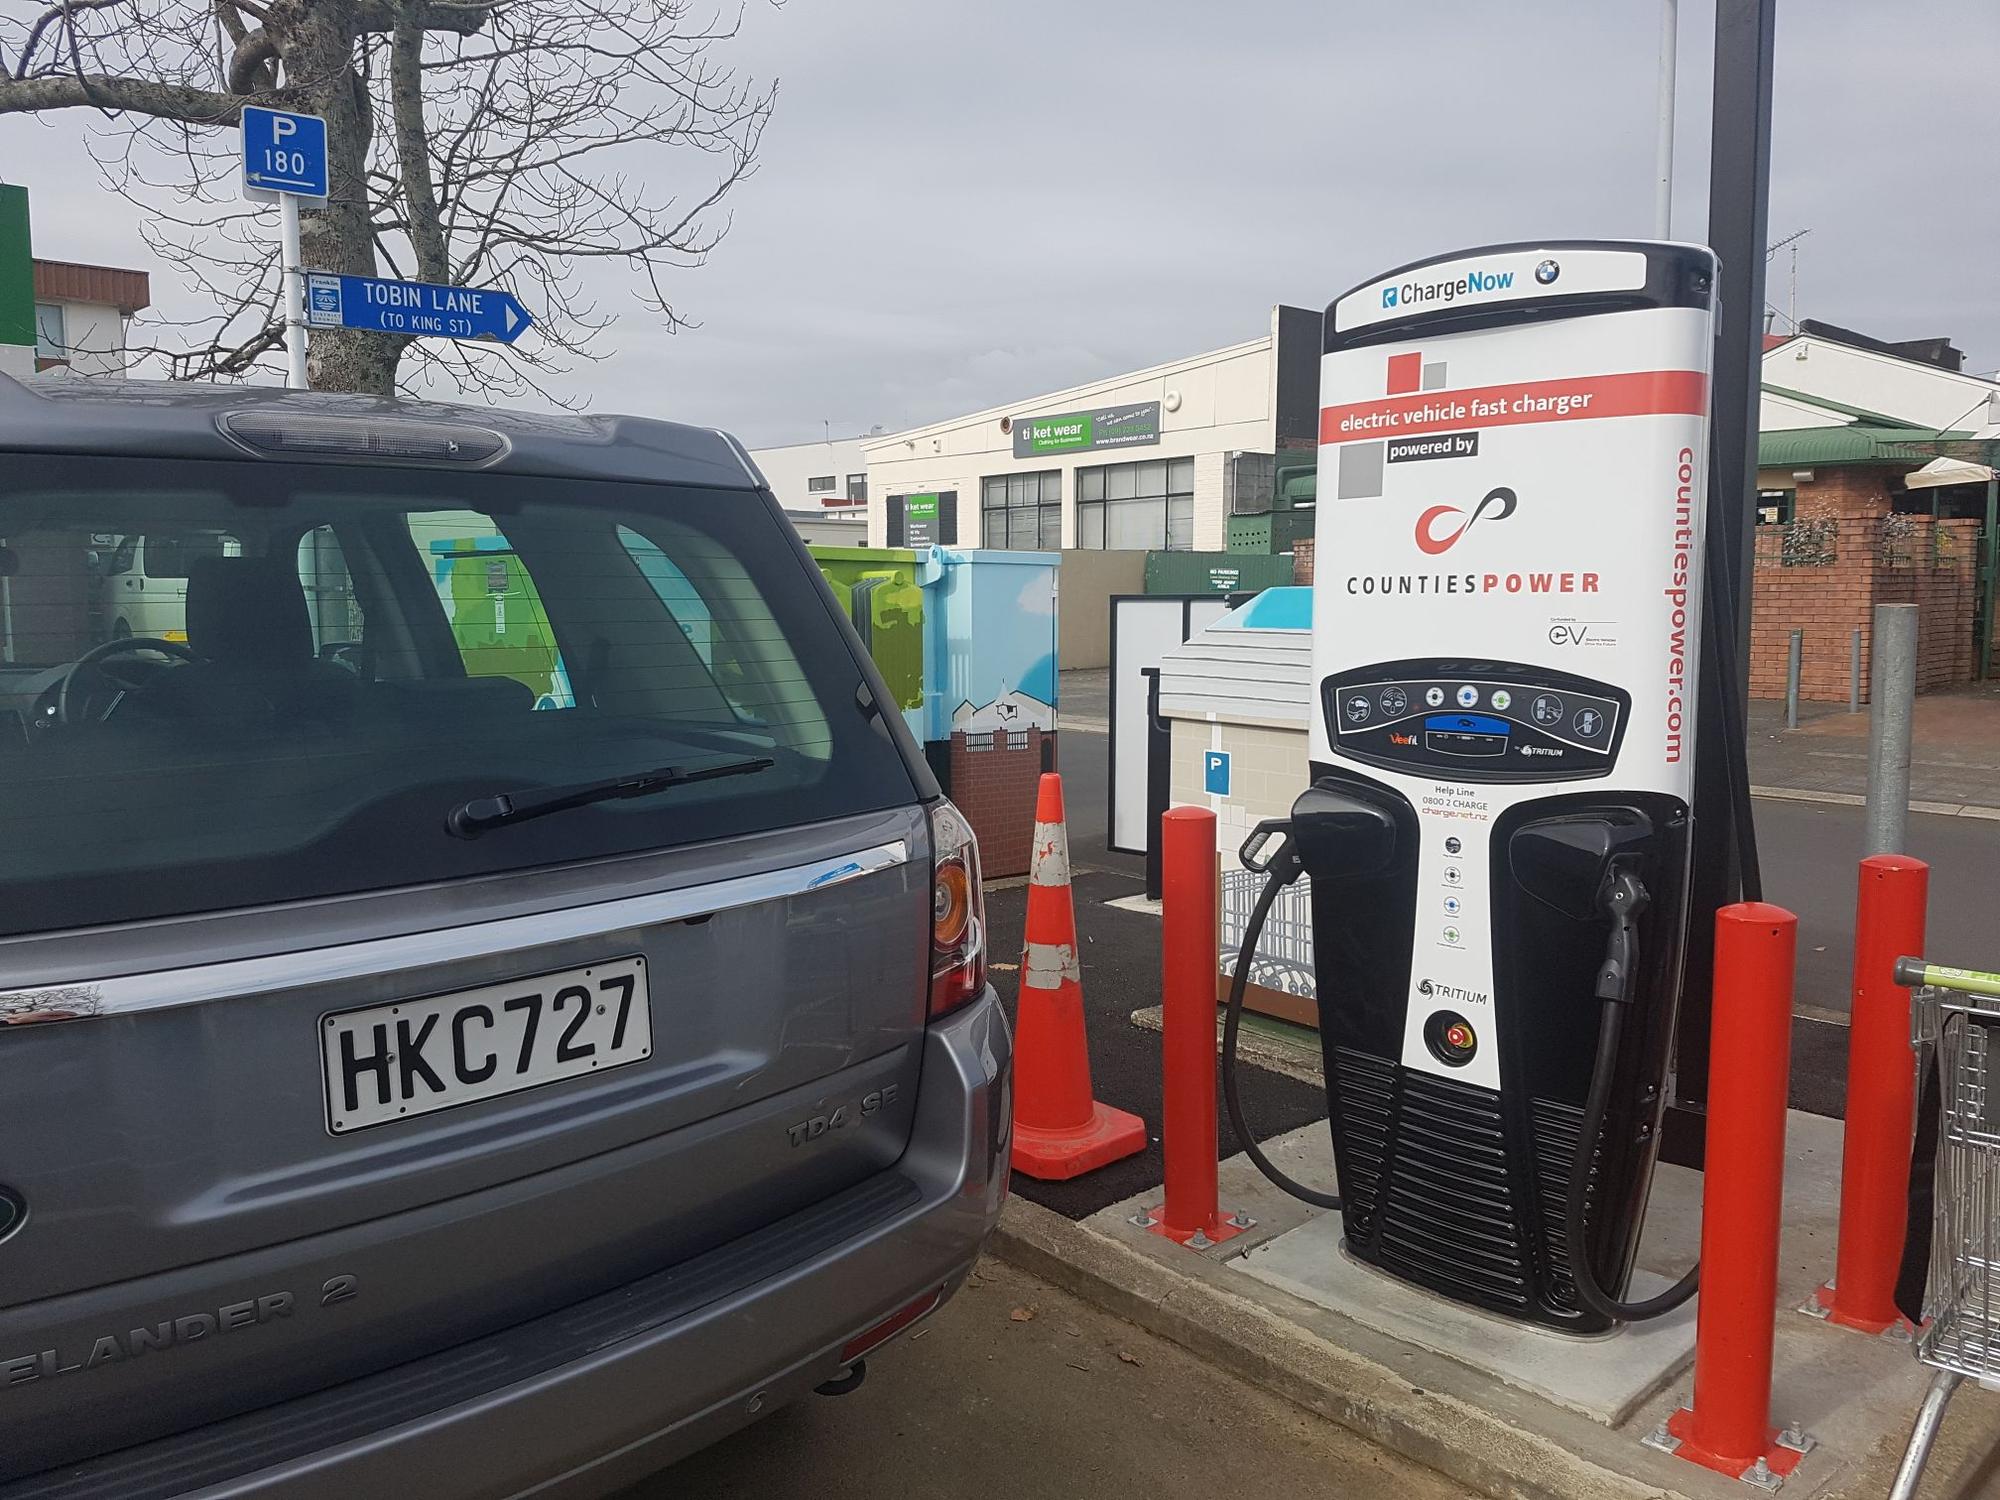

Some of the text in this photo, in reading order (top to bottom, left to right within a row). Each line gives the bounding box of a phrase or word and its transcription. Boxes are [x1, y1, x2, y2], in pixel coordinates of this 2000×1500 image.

[273, 116, 297, 145] P
[265, 149, 305, 175] 180
[363, 283, 484, 315] TOBIN LANE
[1401, 271, 1514, 304] ChargeNow
[380, 311, 472, 336] (TO KING ST)
[1340, 392, 1593, 432] electric vehicle fast charger
[1033, 425, 1051, 439] ket
[1053, 424, 1083, 437] wear
[1390, 436, 1474, 459] powered by
[1347, 572, 1600, 595] COUNTIESPOWER
[1664, 446, 1693, 764] countiespower.com
[1389, 732, 1418, 746] Veefil
[1210, 757, 1222, 771] P
[1532, 747, 1563, 757] TRITIUM
[1422, 796, 1445, 806] 0800
[1452, 800, 1488, 811] CHARGE
[1435, 786, 1475, 797] Help Line
[1422, 806, 1488, 821] charge.net.nz
[1435, 984, 1488, 1005] TRITIUM
[340, 974, 635, 1112] HKC727
[786, 1083, 898, 1148] TD4 SE
[321, 1274, 358, 1307] 2
